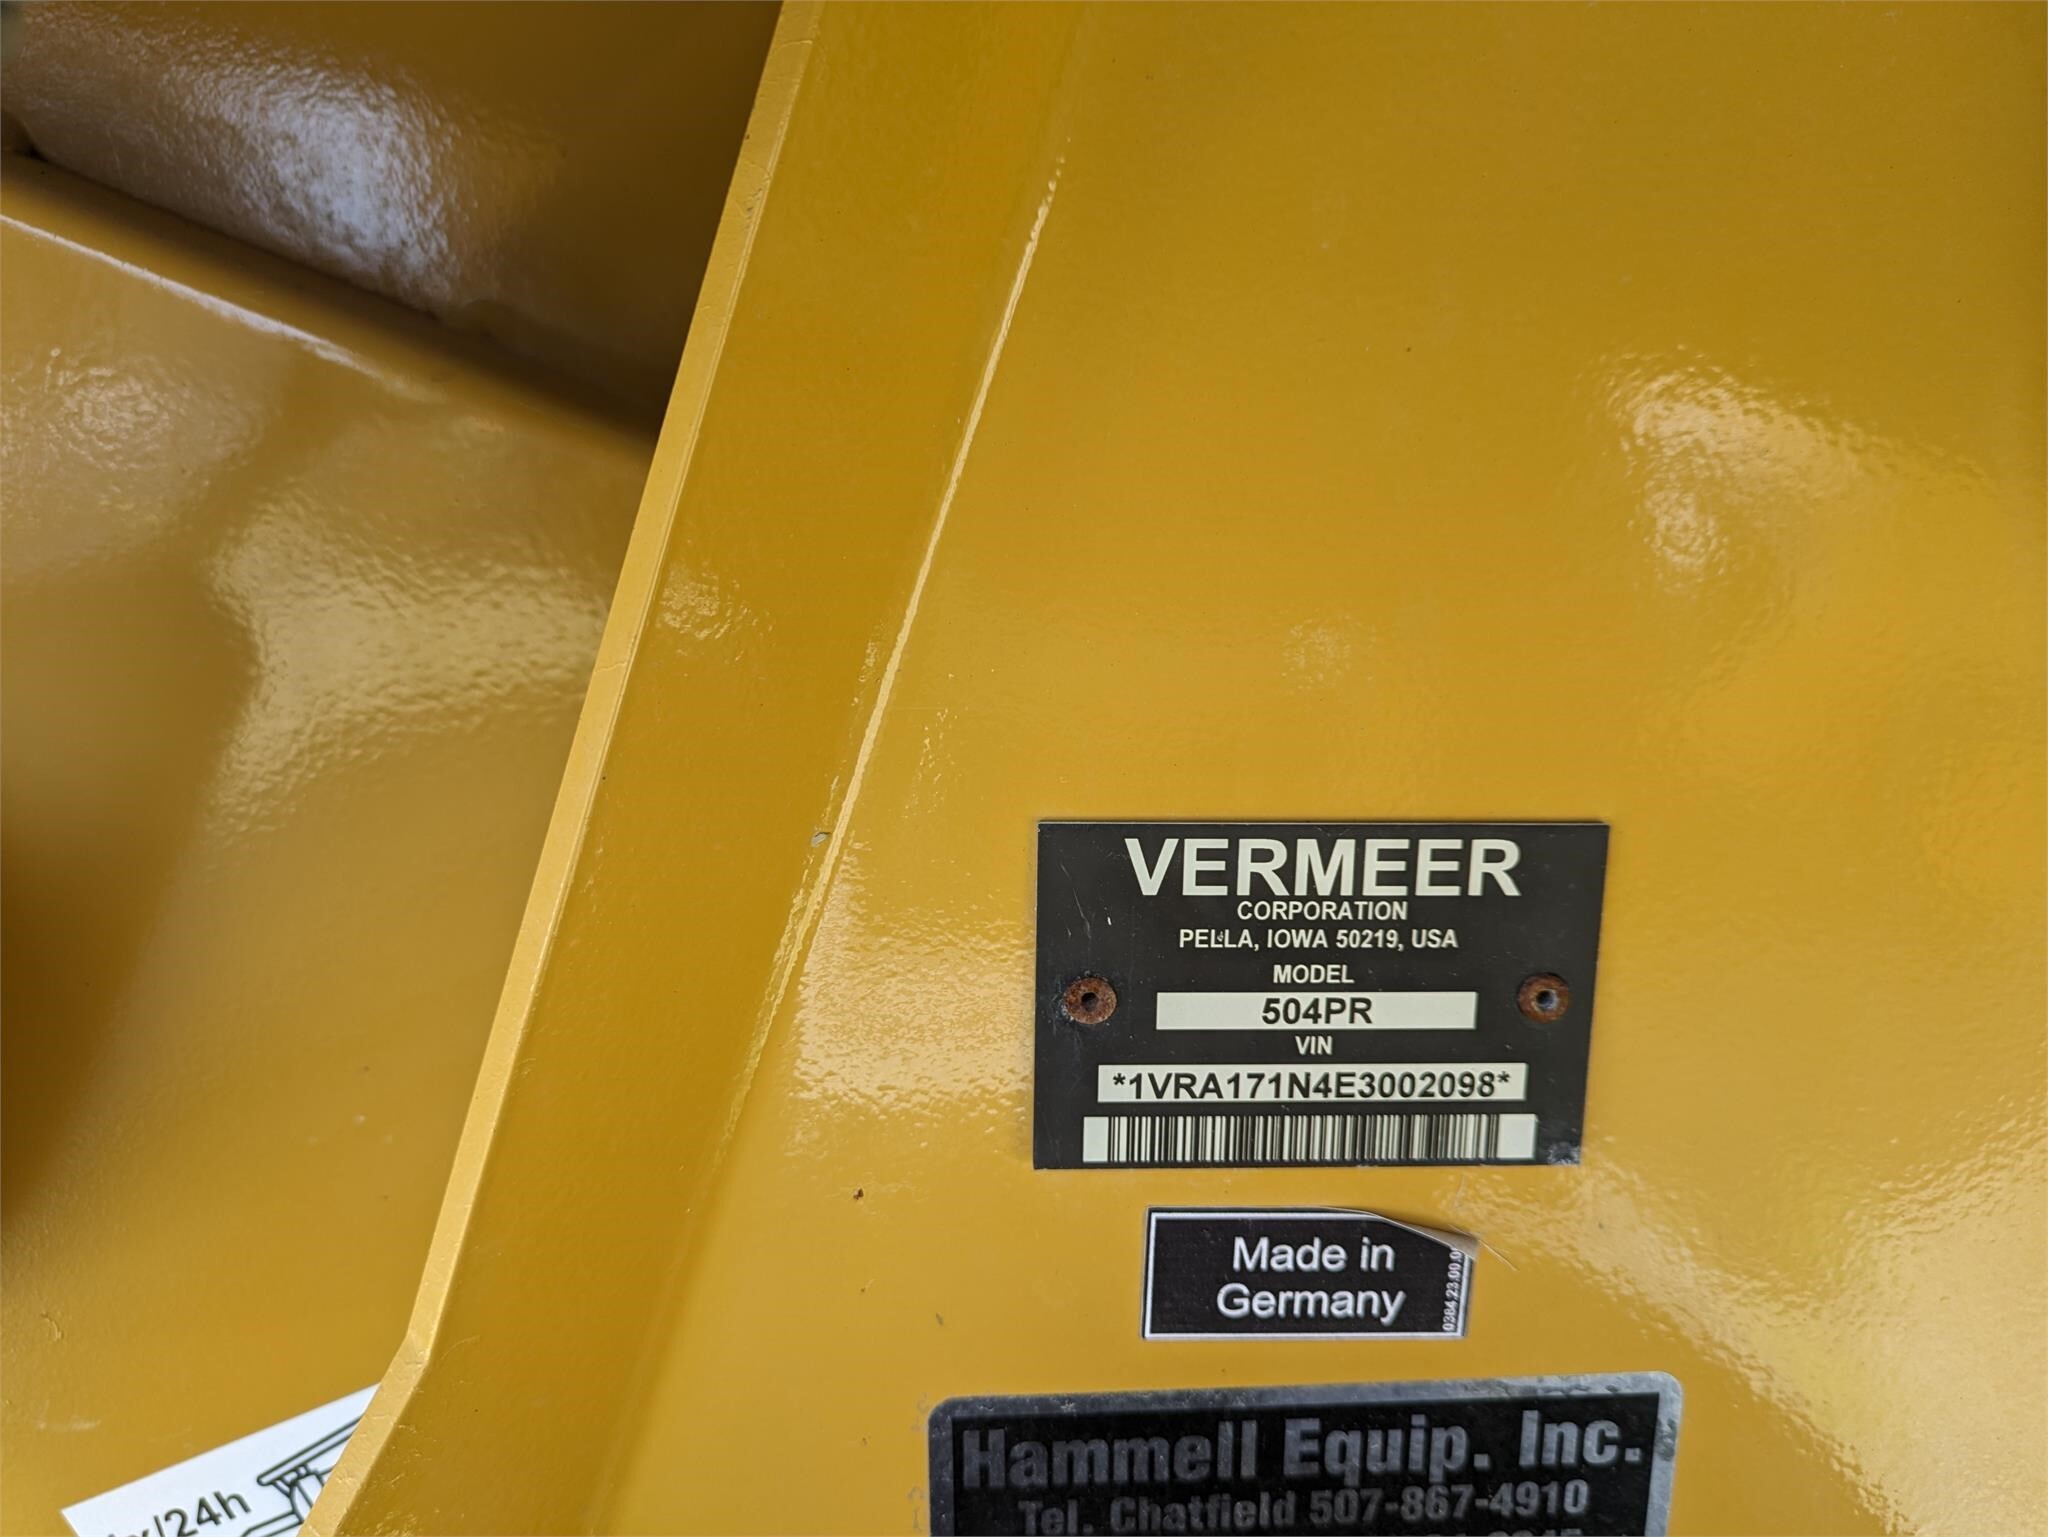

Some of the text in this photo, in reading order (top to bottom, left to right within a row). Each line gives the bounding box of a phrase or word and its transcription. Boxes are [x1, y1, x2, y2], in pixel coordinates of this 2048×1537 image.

[1124, 838, 1522, 896] VERMEER
[1237, 901, 1407, 921] CORPORATION
[1179, 929, 1458, 951] PELLA, IOWA 50219, USA
[1273, 965, 1354, 984] MODEL
[1262, 997, 1373, 1024] 504PR
[1295, 1036, 1333, 1055] VIN
[1232, 1236, 1395, 1272] Made in
[1216, 1282, 1406, 1327] Germany
[963, 1409, 1641, 1489] Hammell Equip. Inc.
[107, 1490, 252, 1537] /24h
[1018, 1478, 1590, 1536] Tel. Chatfield 507-867-4910
